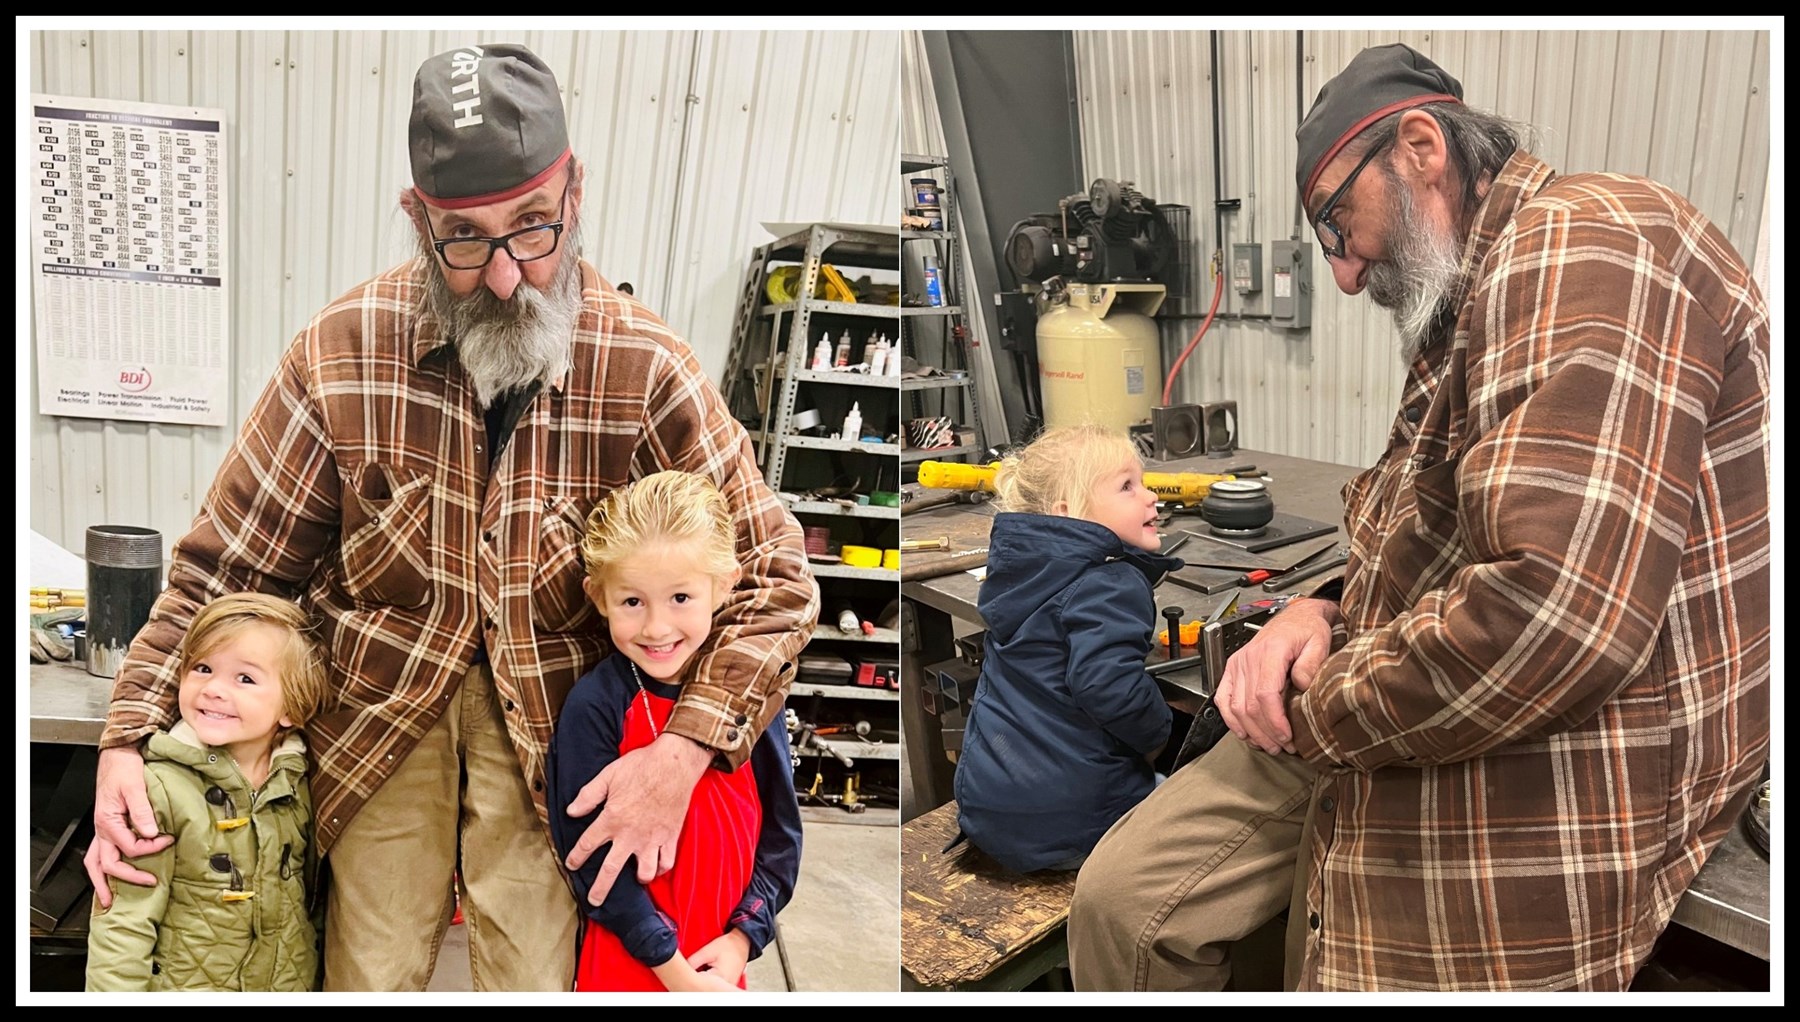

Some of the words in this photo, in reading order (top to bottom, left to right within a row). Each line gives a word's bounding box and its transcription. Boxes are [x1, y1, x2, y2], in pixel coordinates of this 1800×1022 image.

[120, 372, 144, 384] BDI
[1066, 371, 1084, 380] Rand
[61, 389, 90, 397] Bearings
